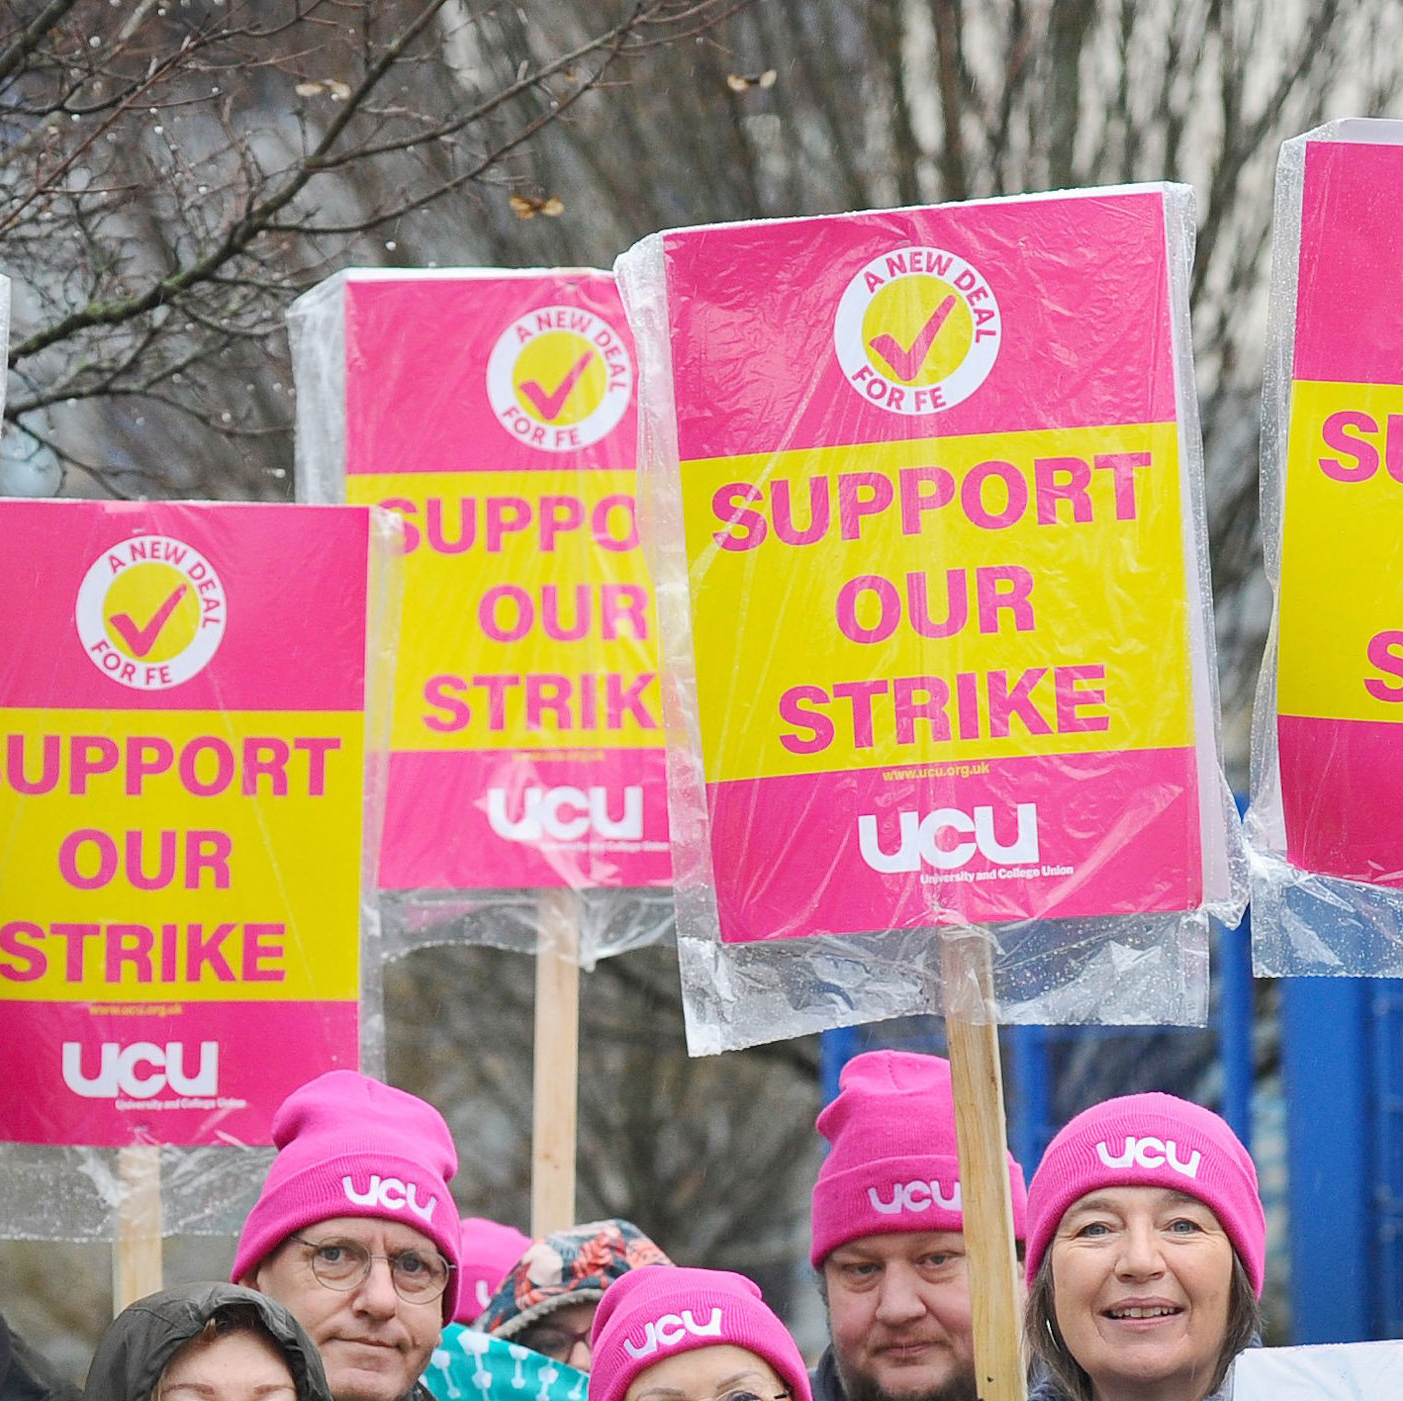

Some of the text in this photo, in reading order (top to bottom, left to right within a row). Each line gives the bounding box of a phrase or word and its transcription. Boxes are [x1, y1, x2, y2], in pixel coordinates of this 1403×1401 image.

[864, 251, 996, 343] A NEW DEAL
[516, 311, 626, 392] A NEW DEAL
[852, 365, 946, 412] FOR FE
[502, 406, 580, 447] FOR FE
[711, 452, 1152, 552] SUPPORT
[107, 541, 220, 628] A NEW DEAL
[477, 583, 649, 643] OUR
[835, 565, 1035, 645] OUR
[91, 640, 172, 685] FOR FE
[777, 663, 1110, 755] STRIKE
[882, 762, 989, 781] www.ucu.org.uk
[58, 829, 233, 890] OUR
[920, 866, 1073, 884] University and College Union
